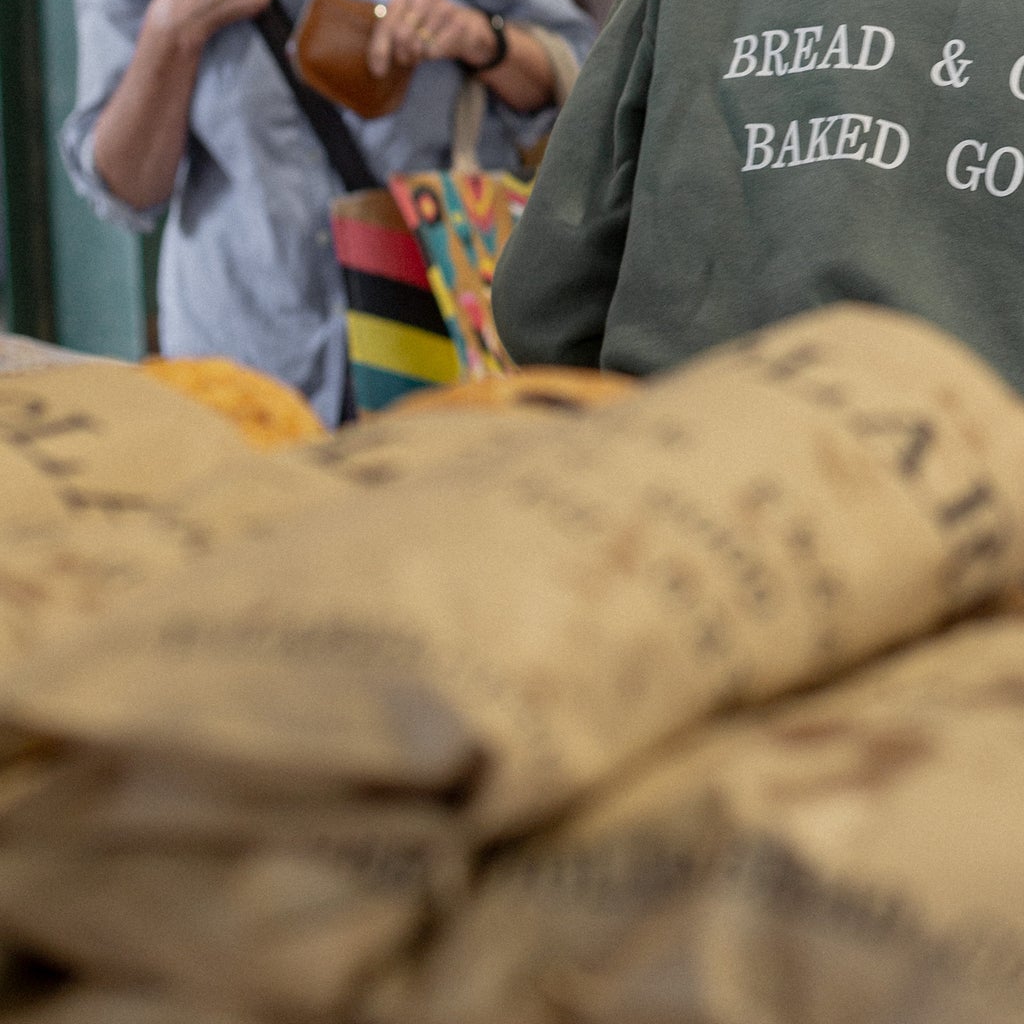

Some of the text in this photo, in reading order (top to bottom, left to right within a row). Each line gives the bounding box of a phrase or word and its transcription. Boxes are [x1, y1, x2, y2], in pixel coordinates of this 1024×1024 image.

[722, 23, 896, 80] BREAD
[930, 38, 974, 89] &
[741, 113, 910, 172] BAKED
